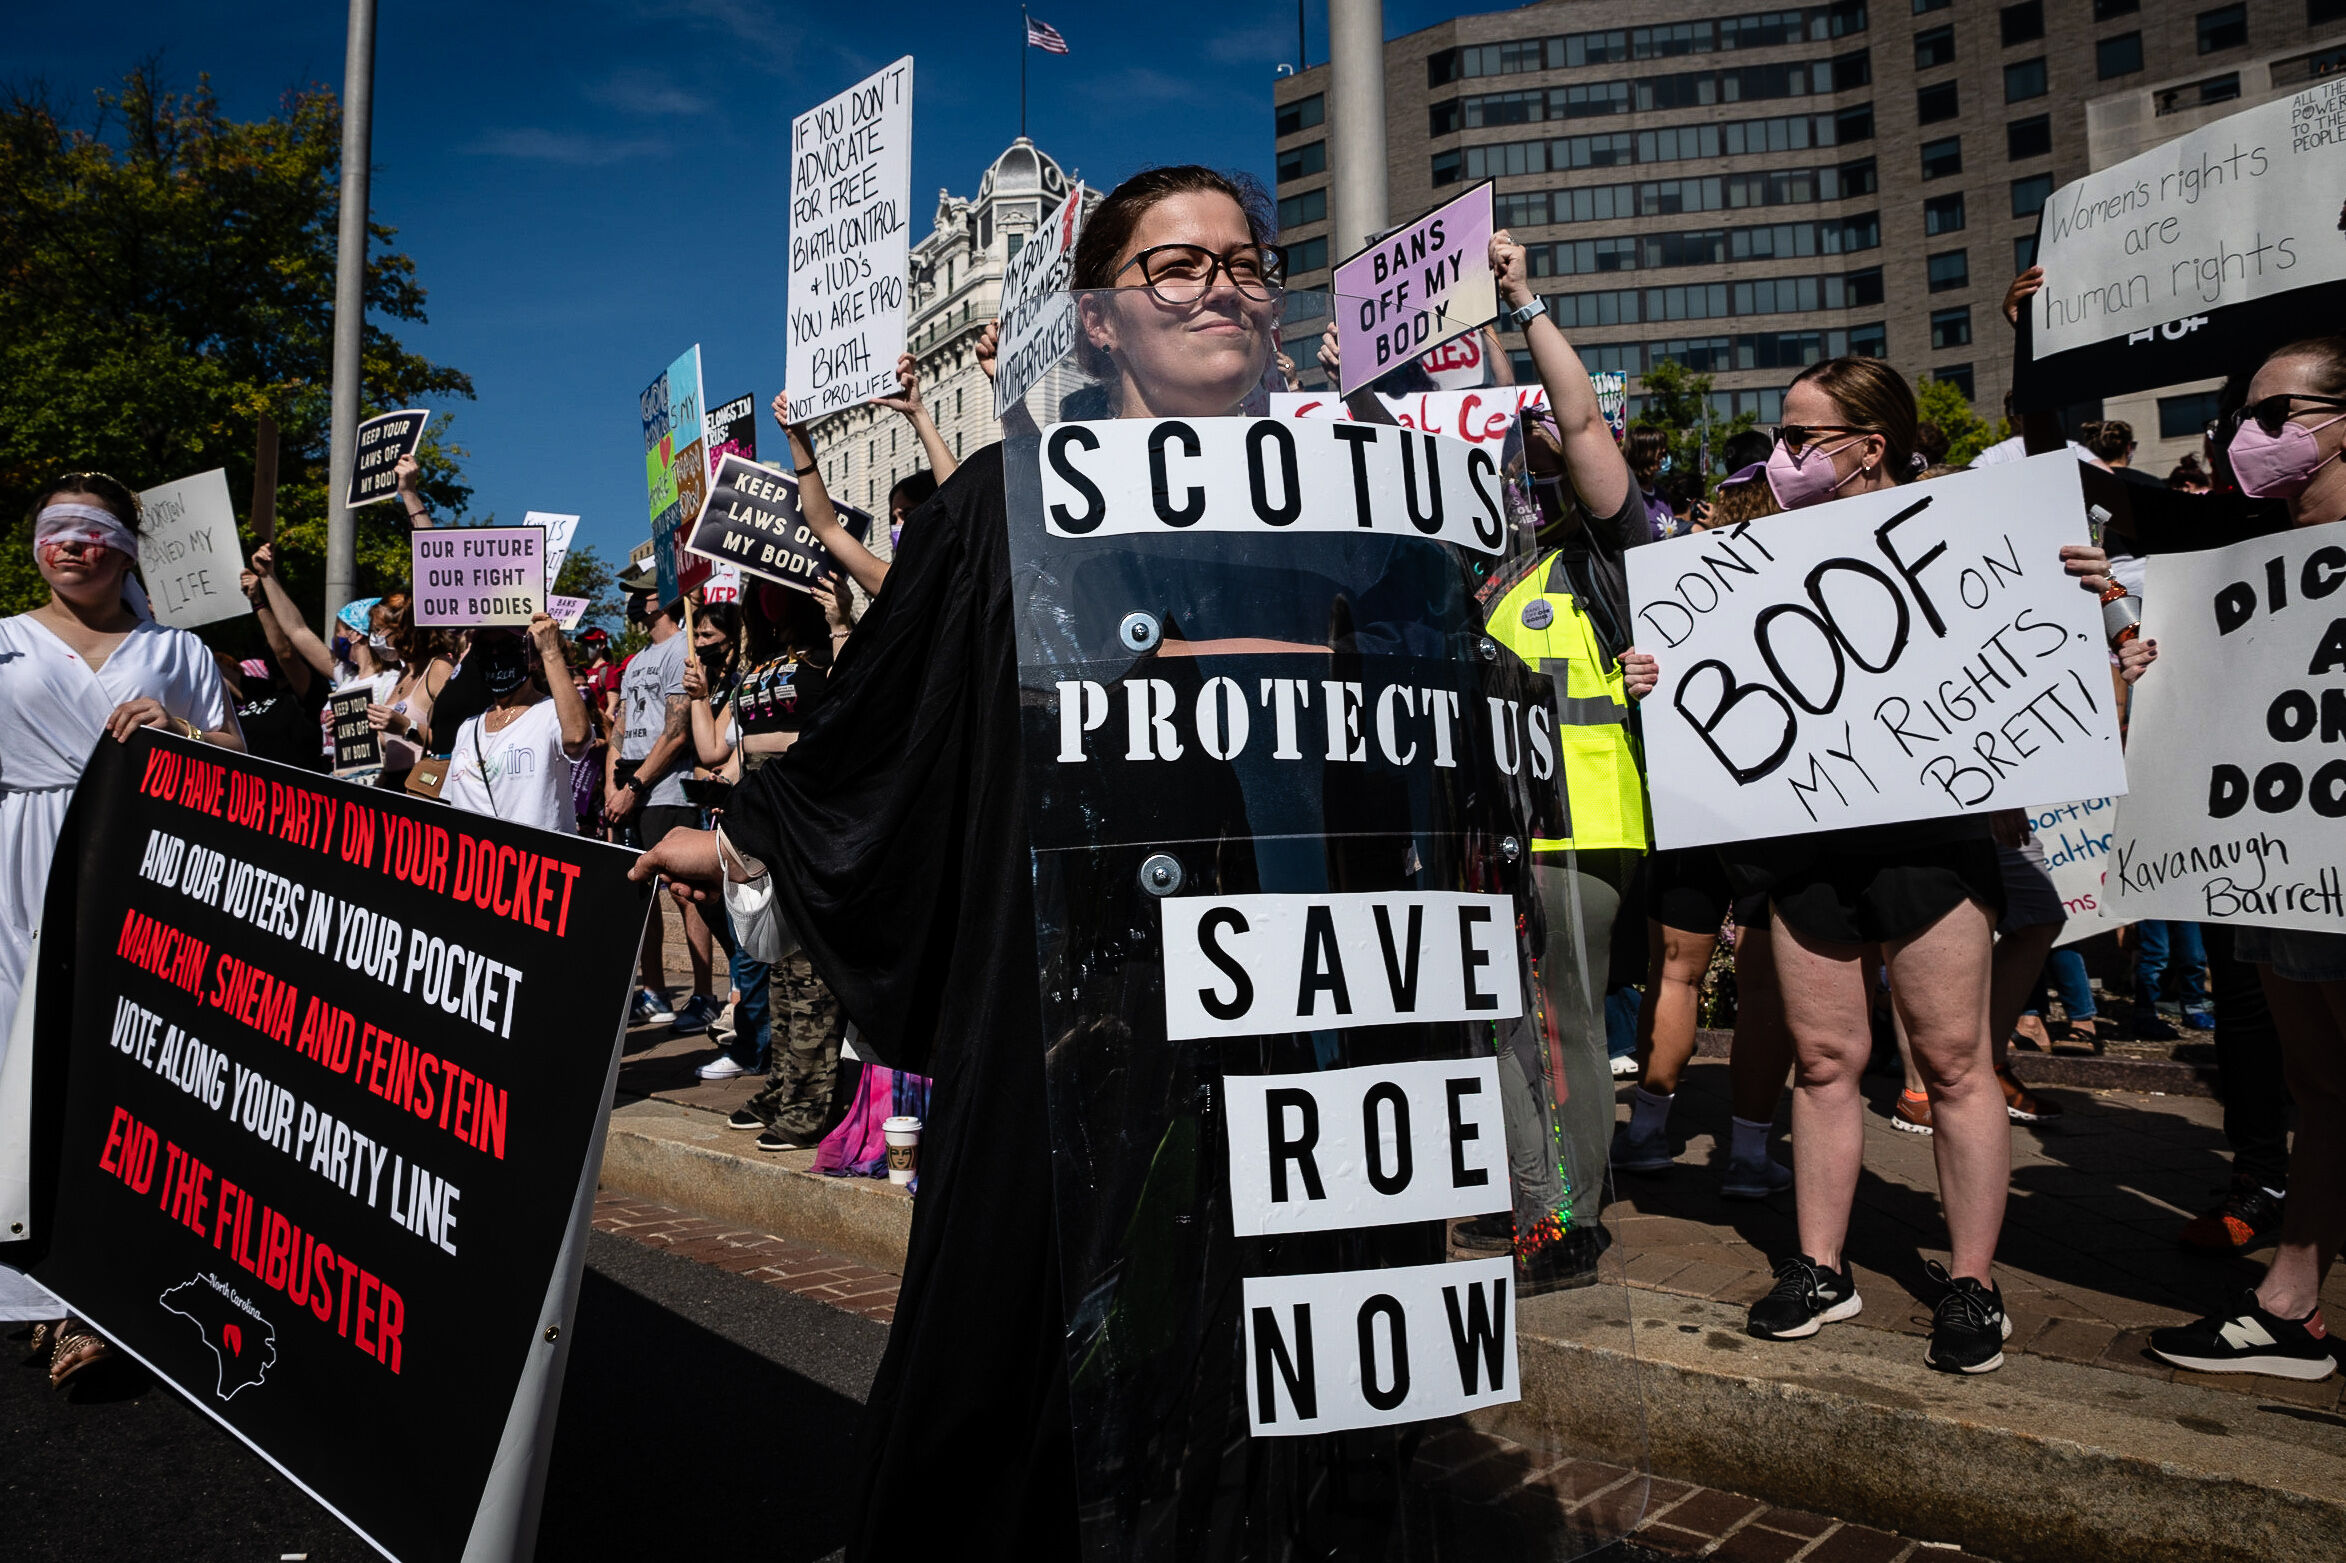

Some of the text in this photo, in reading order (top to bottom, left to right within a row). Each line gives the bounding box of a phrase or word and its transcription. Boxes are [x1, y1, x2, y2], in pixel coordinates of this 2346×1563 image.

[795, 67, 905, 152] IF YOU DON'T
[2291, 109, 2346, 137] TO THE
[2292, 94, 2346, 124] POWER
[2293, 80, 2346, 108] ALL THE
[796, 118, 884, 195] ADVOCATE
[2292, 124, 2346, 154] PEOPLE
[794, 162, 879, 228] FOR FREE
[2051, 143, 2268, 243] Women's rights
[793, 198, 905, 273] BIRTH CONTROL
[1000, 214, 1060, 307] MY BODY
[1373, 219, 1446, 285] BANS
[2124, 216, 2180, 255] are
[791, 276, 902, 347] YOU ARE PRO
[1016, 247, 1072, 337] BUSINESS
[1360, 249, 1463, 332] OFF MY
[2046, 233, 2297, 330] human rights
[812, 332, 871, 389] BIRTH
[993, 303, 1074, 416] MOTHERFUCKER
[1376, 300, 1449, 367] BODY
[361, 420, 410, 447] KEEP YOUR
[706, 397, 752, 429] ELONGS IN
[789, 395, 816, 422] NOT
[360, 444, 401, 470] LAWS OFF
[361, 470, 396, 493] MY BODY
[734, 473, 788, 503] KEEP
[1047, 418, 1502, 550] SCOTUS
[189, 526, 213, 553] MY
[421, 539, 534, 558] OUR FUTURE
[722, 531, 756, 555] MY
[760, 544, 819, 577] BODY
[728, 502, 826, 552] LAWS OF
[160, 570, 217, 613] LIFE
[424, 598, 533, 615] OUR BODIES
[429, 569, 525, 586] OUR FIGHT
[557, 600, 577, 608] BANS
[1639, 521, 1774, 648] DON'T
[2213, 545, 2346, 636] DIC
[1674, 496, 2023, 786] BOOF ON
[333, 697, 367, 717] KEEP YOUR
[338, 720, 369, 739] LAWS OFF
[1055, 676, 1554, 781] PROTECT US
[1920, 669, 2111, 809] BRETT!
[342, 743, 371, 761] MY BODY
[1788, 721, 1880, 822] MY
[140, 748, 581, 937] YOU HAVE OUR PARTY ON YOUR DOCKET
[2118, 832, 2289, 897] Kavanaugh
[2202, 866, 2345, 918] Barrett
[140, 830, 522, 1039] AND OUR VOTERS IN YOUR POCKET
[1198, 905, 1500, 1021] SAVE
[117, 909, 507, 1160] MANCHIN, SINEMA AND FEINSTEIN
[111, 996, 459, 1256] VOTE ALONG YOUR PARTY LINE
[1265, 1077, 1489, 1203] ROE
[99, 1106, 404, 1374] END THE FILIBUSTER
[209, 1273, 261, 1320] North Carolina
[1252, 1277, 1507, 1425] NOW
